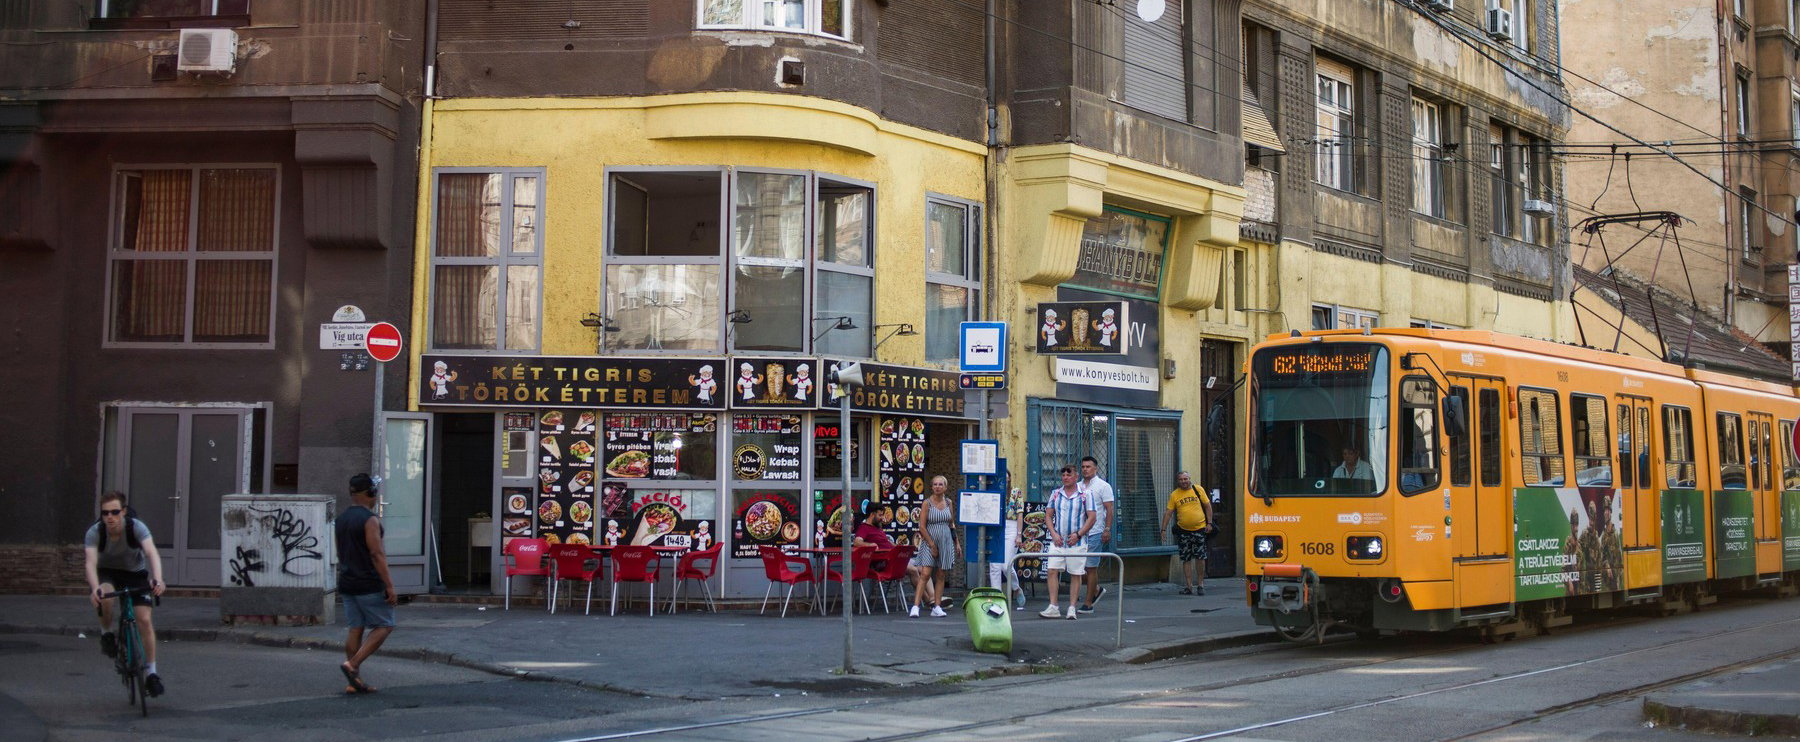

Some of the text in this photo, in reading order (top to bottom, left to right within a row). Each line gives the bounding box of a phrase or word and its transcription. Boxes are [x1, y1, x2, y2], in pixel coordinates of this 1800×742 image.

[1077, 235, 1160, 284] HÁNYBOLT
[333, 330, 364, 343] Víg utca
[492, 363, 652, 383] KÉT TIGRIS
[1274, 356, 1296, 374] 62
[866, 370, 897, 388] KÉT
[902, 375, 957, 393] TIGRIS
[1061, 367, 1150, 384] www.konyvesbolt.hu
[456, 382, 689, 404] TÖRÖK ÉTTEREM
[853, 387, 964, 413] ÖRÖK ÉTTERE
[607, 443, 651, 451] Gyros pitában
[774, 445, 799, 455] Wrap
[769, 457, 799, 466] Kebab
[763, 471, 799, 479] Lawash
[631, 492, 687, 513] AKCIÓ!
[1264, 515, 1301, 523] BUDAPEST
[1300, 542, 1334, 555] 1608
[1518, 538, 1559, 551] CSATLAKOZZ
[1519, 552, 1577, 569] A TERÜLETVÉDELMI
